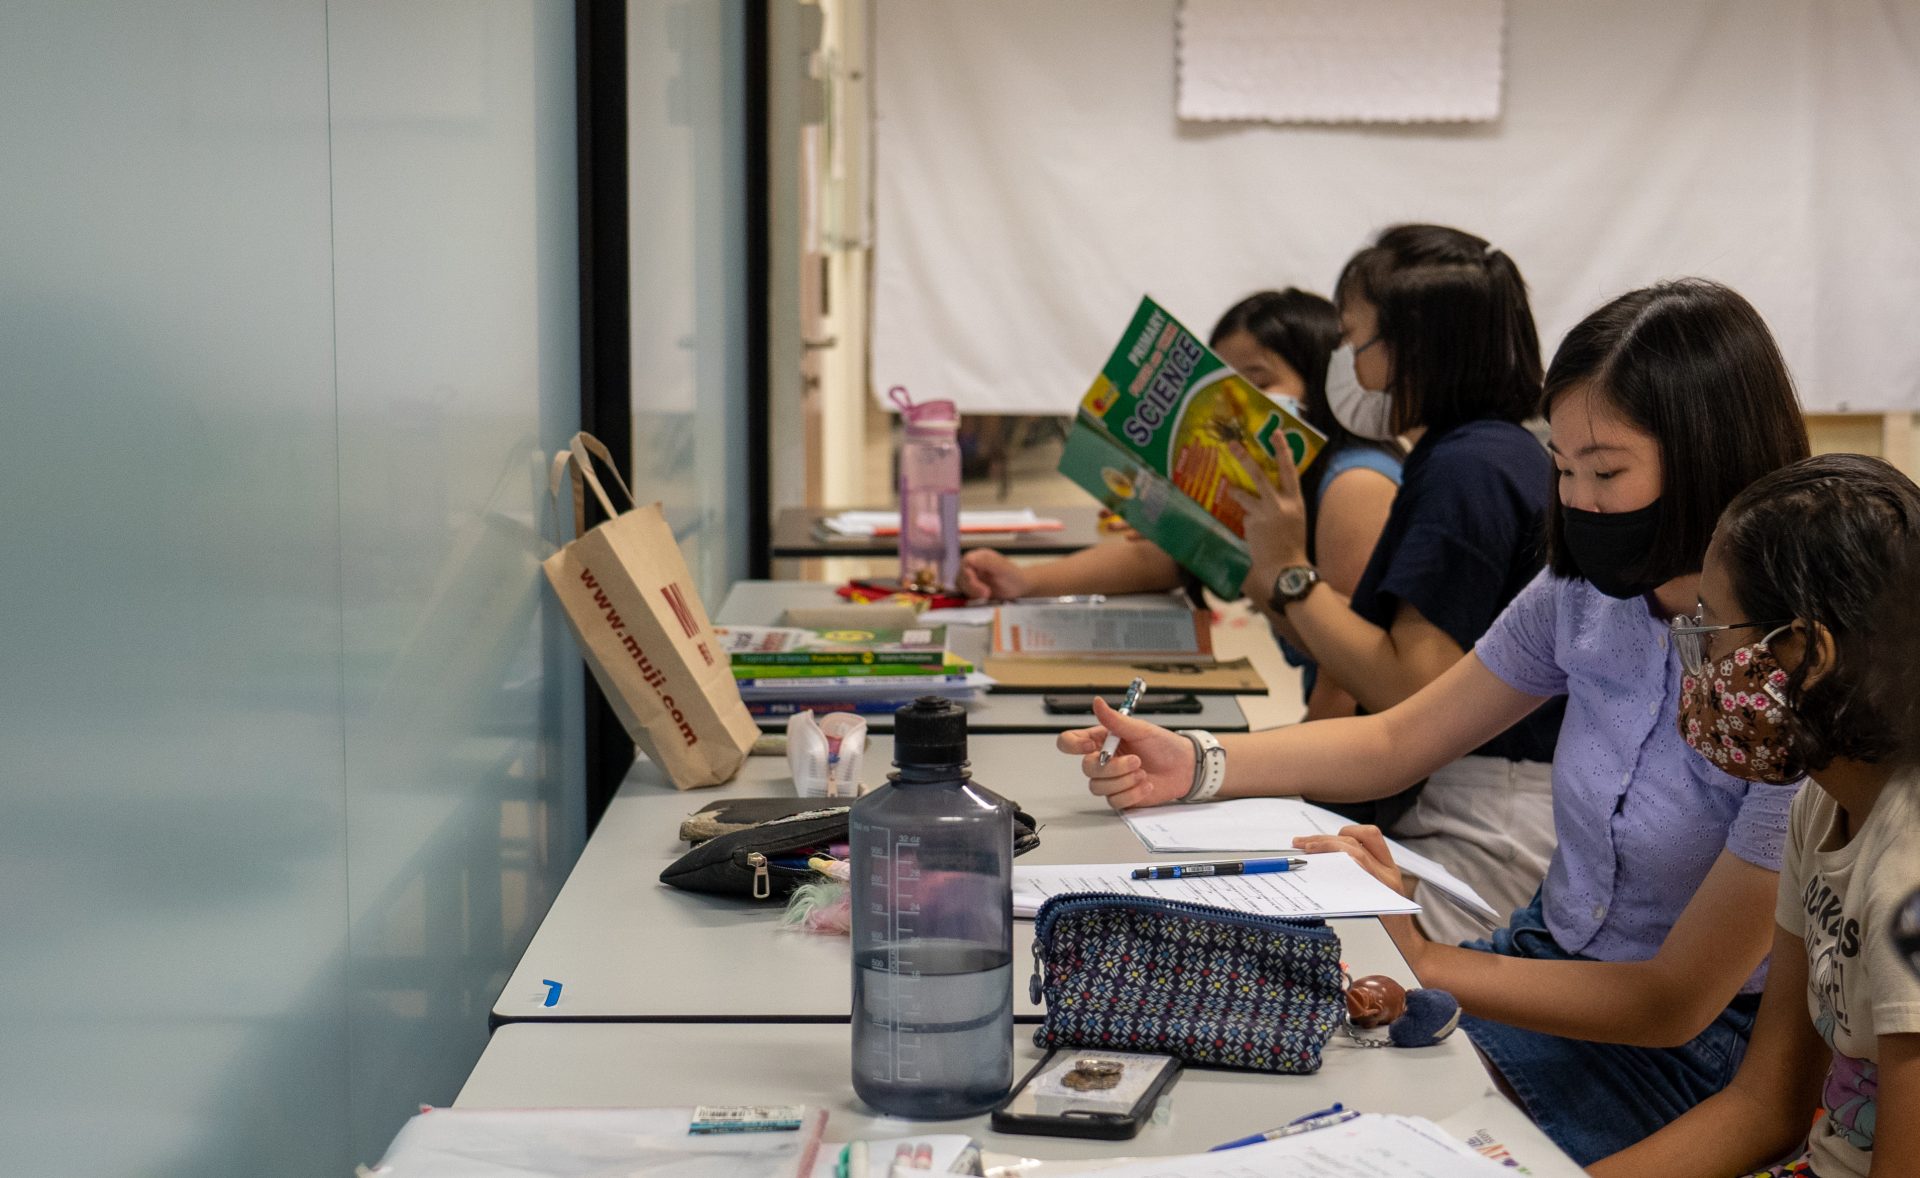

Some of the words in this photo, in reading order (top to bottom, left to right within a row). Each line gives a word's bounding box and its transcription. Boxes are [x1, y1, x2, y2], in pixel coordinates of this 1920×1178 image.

[1124, 333, 1202, 446] SCIENCE
[1127, 308, 1168, 367] PRIMARY
[579, 567, 699, 748] www.muji.com
